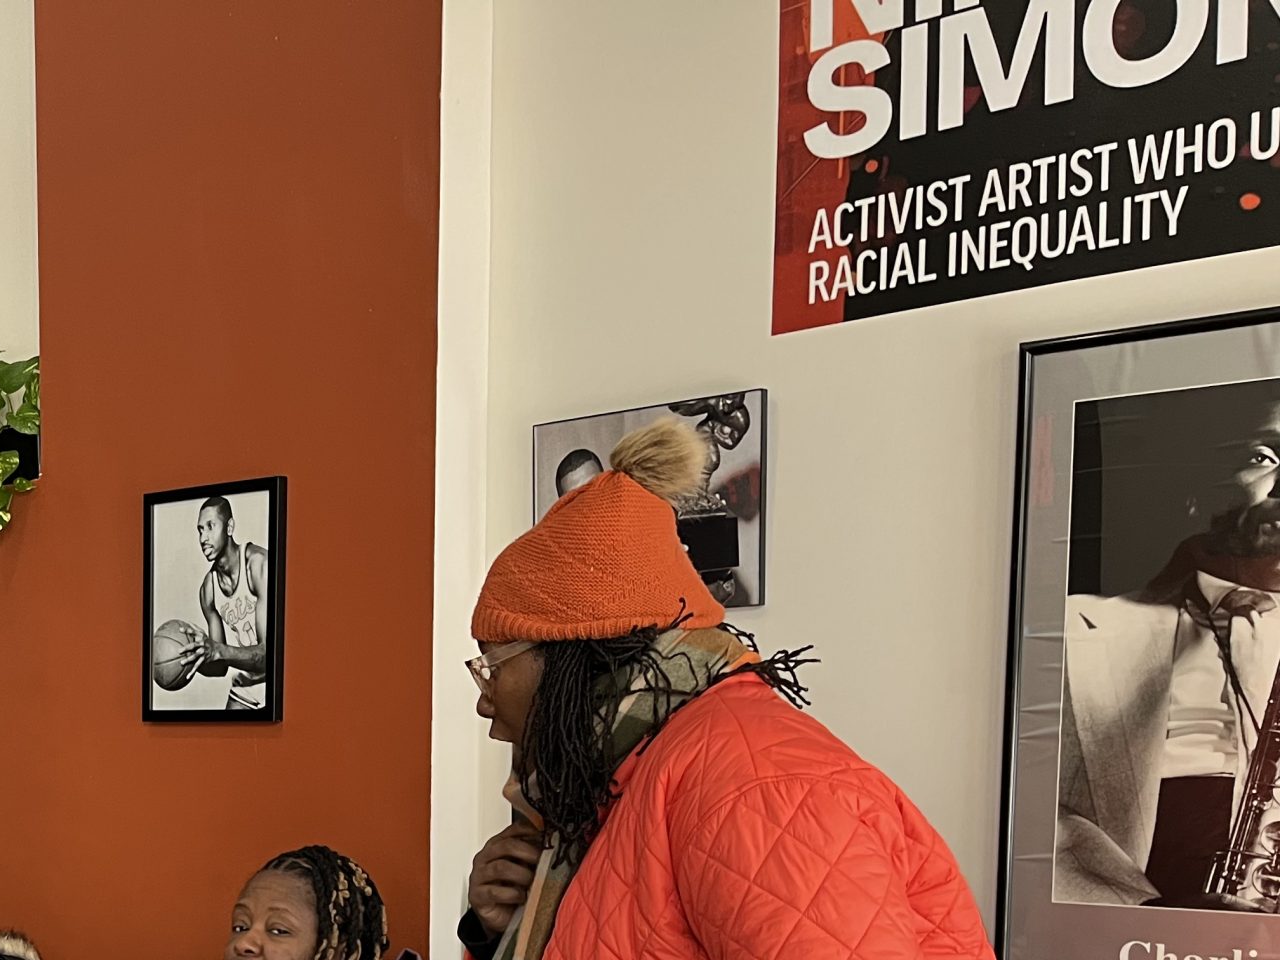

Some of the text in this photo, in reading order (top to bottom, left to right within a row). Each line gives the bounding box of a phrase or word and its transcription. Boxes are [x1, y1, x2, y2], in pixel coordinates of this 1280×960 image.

[808, 174, 971, 254] ACTIVIST
[978, 142, 1118, 217] ARTIST
[1127, 117, 1237, 185] WHO
[808, 185, 1189, 305] RACIAL INEQUALITY
